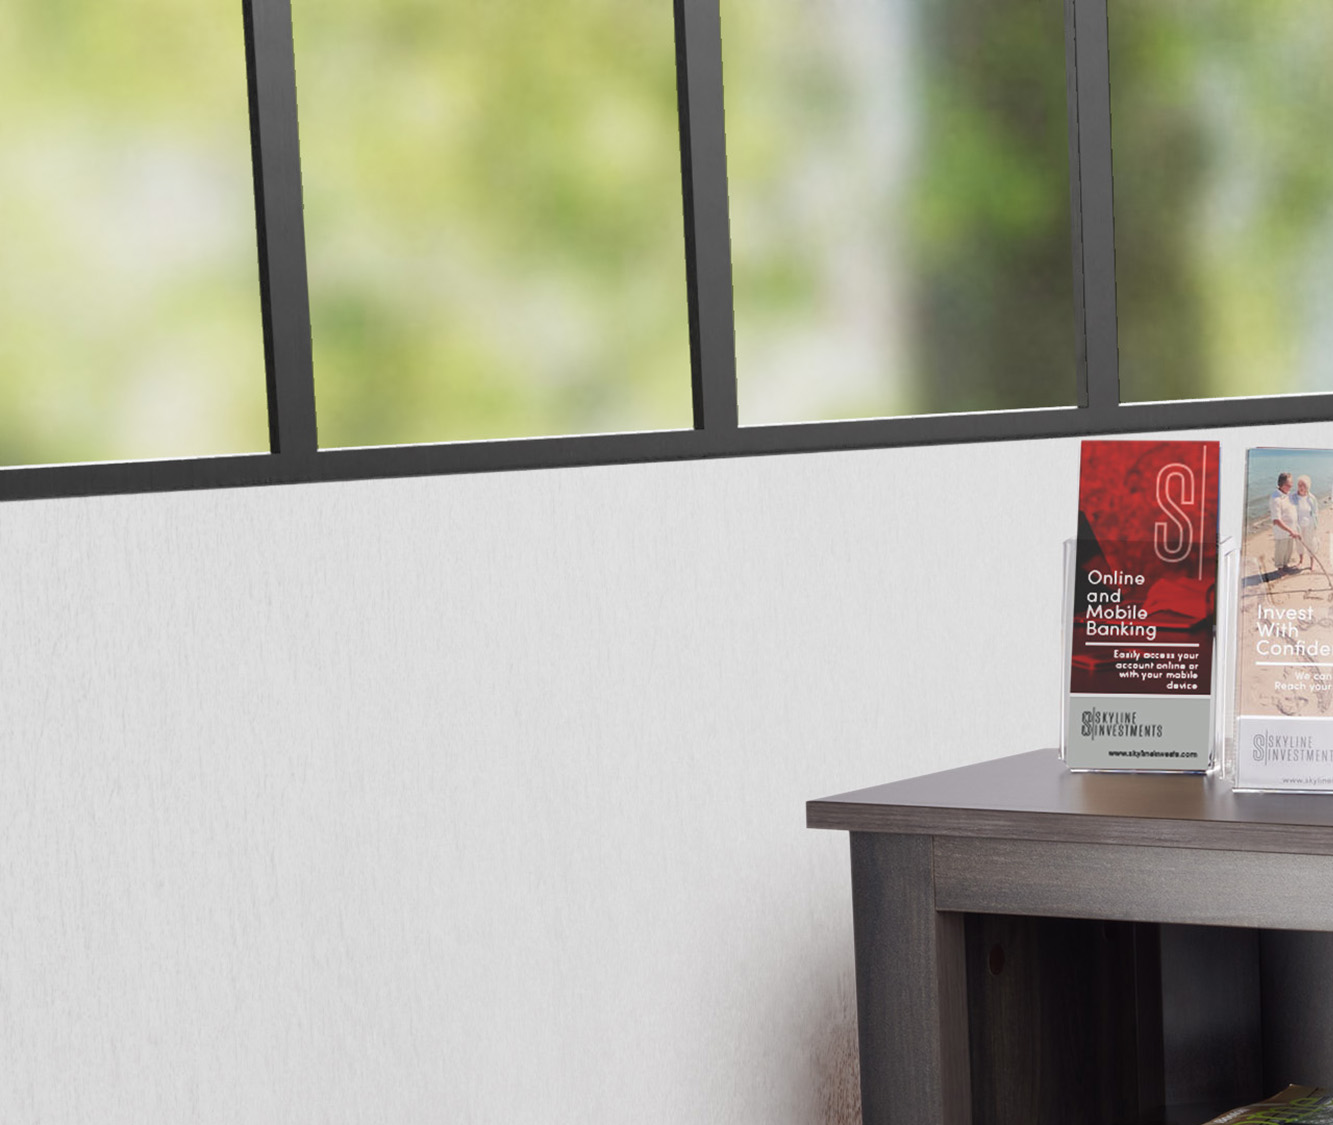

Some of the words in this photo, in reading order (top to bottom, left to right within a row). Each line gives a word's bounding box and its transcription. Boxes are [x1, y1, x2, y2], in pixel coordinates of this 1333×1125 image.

[1088, 569, 1145, 585] Online
[1086, 588, 1121, 603] and
[1086, 604, 1148, 620] Mobile
[1257, 604, 1314, 620] Invest
[1086, 621, 1157, 641] Banking
[1257, 622, 1299, 637] With
[1114, 649, 1140, 661] Easily
[1177, 653, 1199, 661] your
[1115, 662, 1154, 670] account
[1156, 661, 1186, 670] online
[1119, 670, 1139, 678] with
[1141, 673, 1163, 681] your
[1166, 671, 1198, 679] mobile
[1295, 671, 1310, 680] We
[1166, 681, 1198, 690] device
[1275, 681, 1306, 690] Reach
[1309, 683, 1332, 692] your
[1095, 711, 1137, 724] SKYLINE
[1095, 724, 1163, 738] INVESTMENTS
[1268, 735, 1313, 749] SKYLINE
